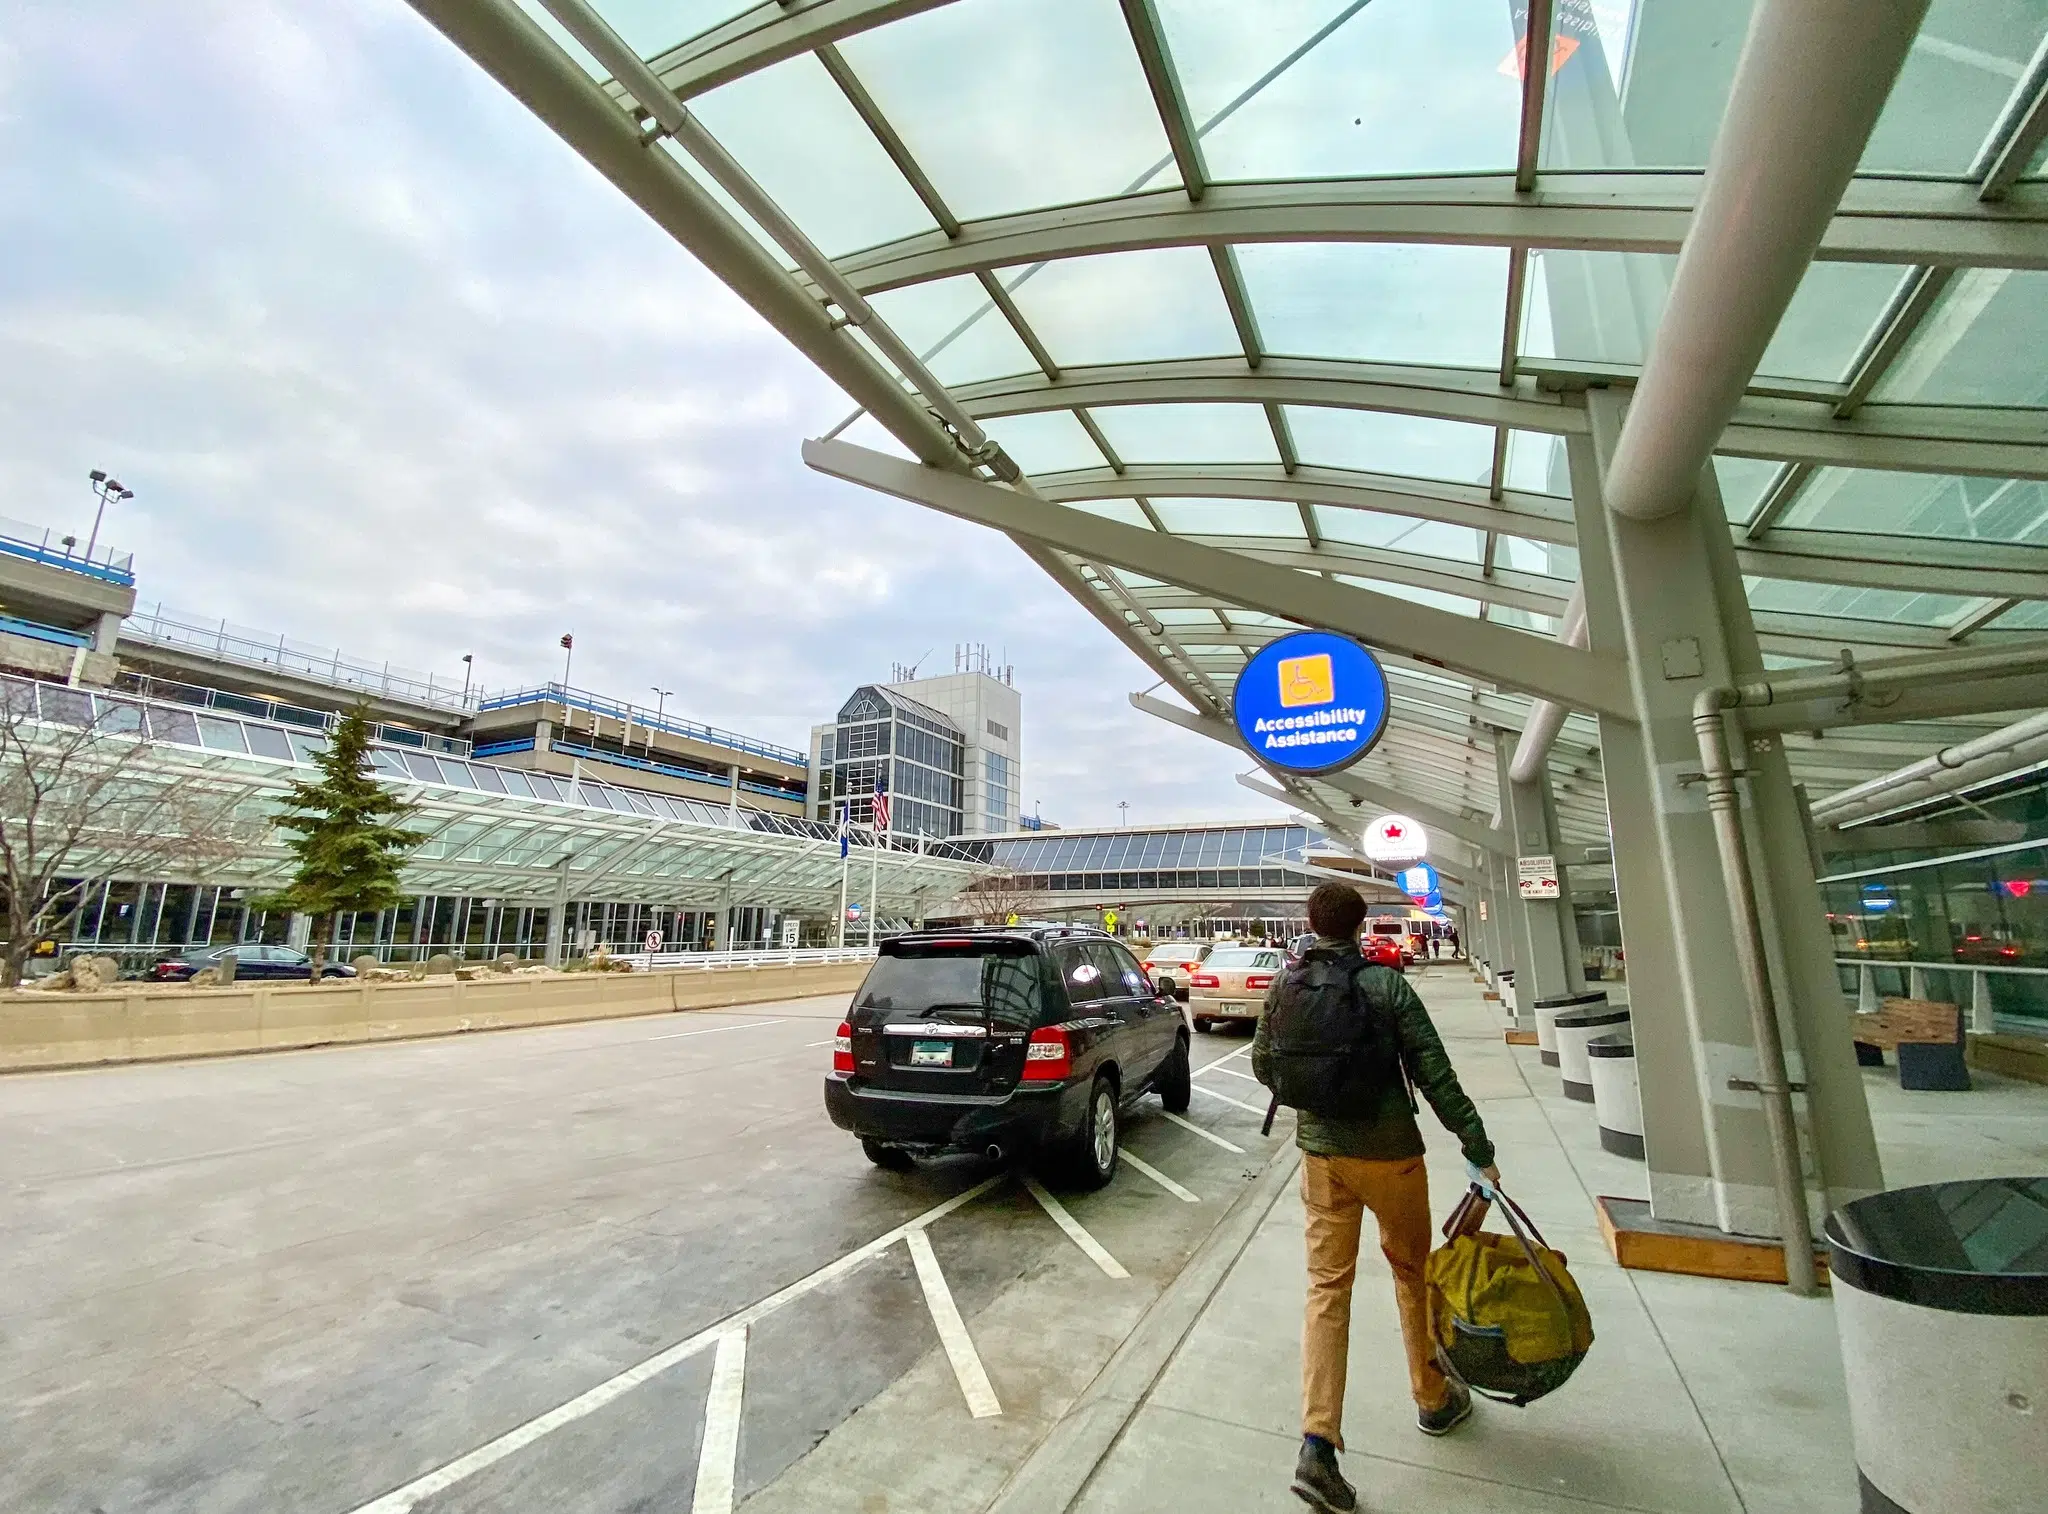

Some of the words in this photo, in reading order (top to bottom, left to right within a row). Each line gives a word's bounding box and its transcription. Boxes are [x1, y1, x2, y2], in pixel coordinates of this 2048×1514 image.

[1254, 708, 1367, 733] Accessibility
[1265, 728, 1357, 749] Assistance
[786, 933, 795, 943] 15
